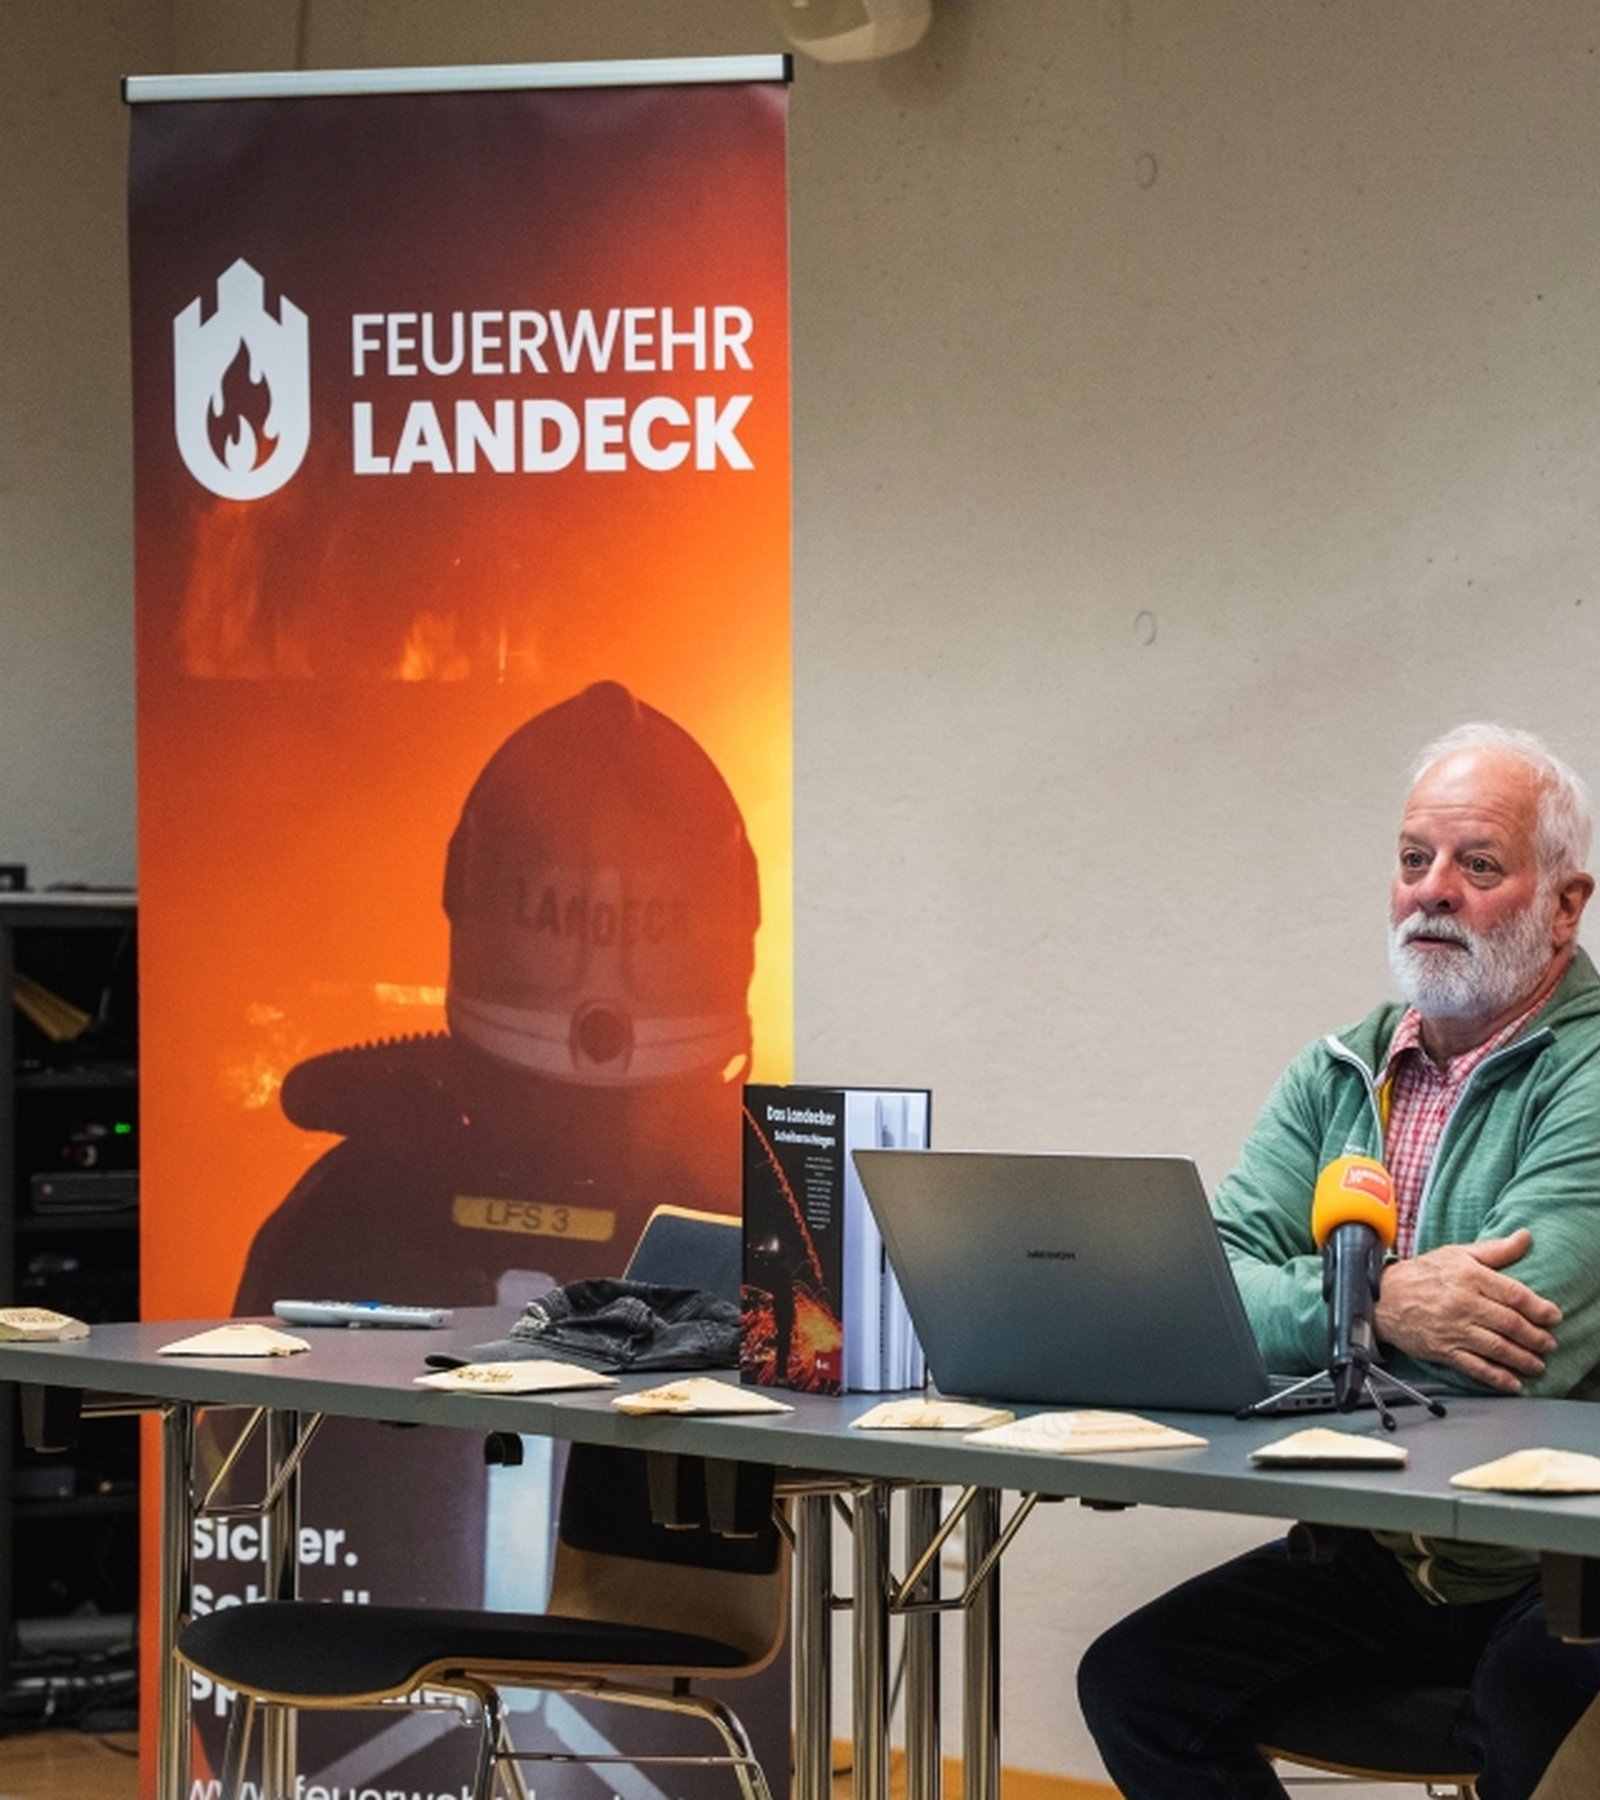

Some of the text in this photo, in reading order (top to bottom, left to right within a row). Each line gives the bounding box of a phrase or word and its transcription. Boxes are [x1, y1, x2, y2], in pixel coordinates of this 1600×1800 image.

[352, 306, 754, 376] FEUERWEHR
[352, 395, 755, 475] LANDECK
[766, 1104, 786, 1121] Das
[485, 1202, 571, 1234] LFS 3
